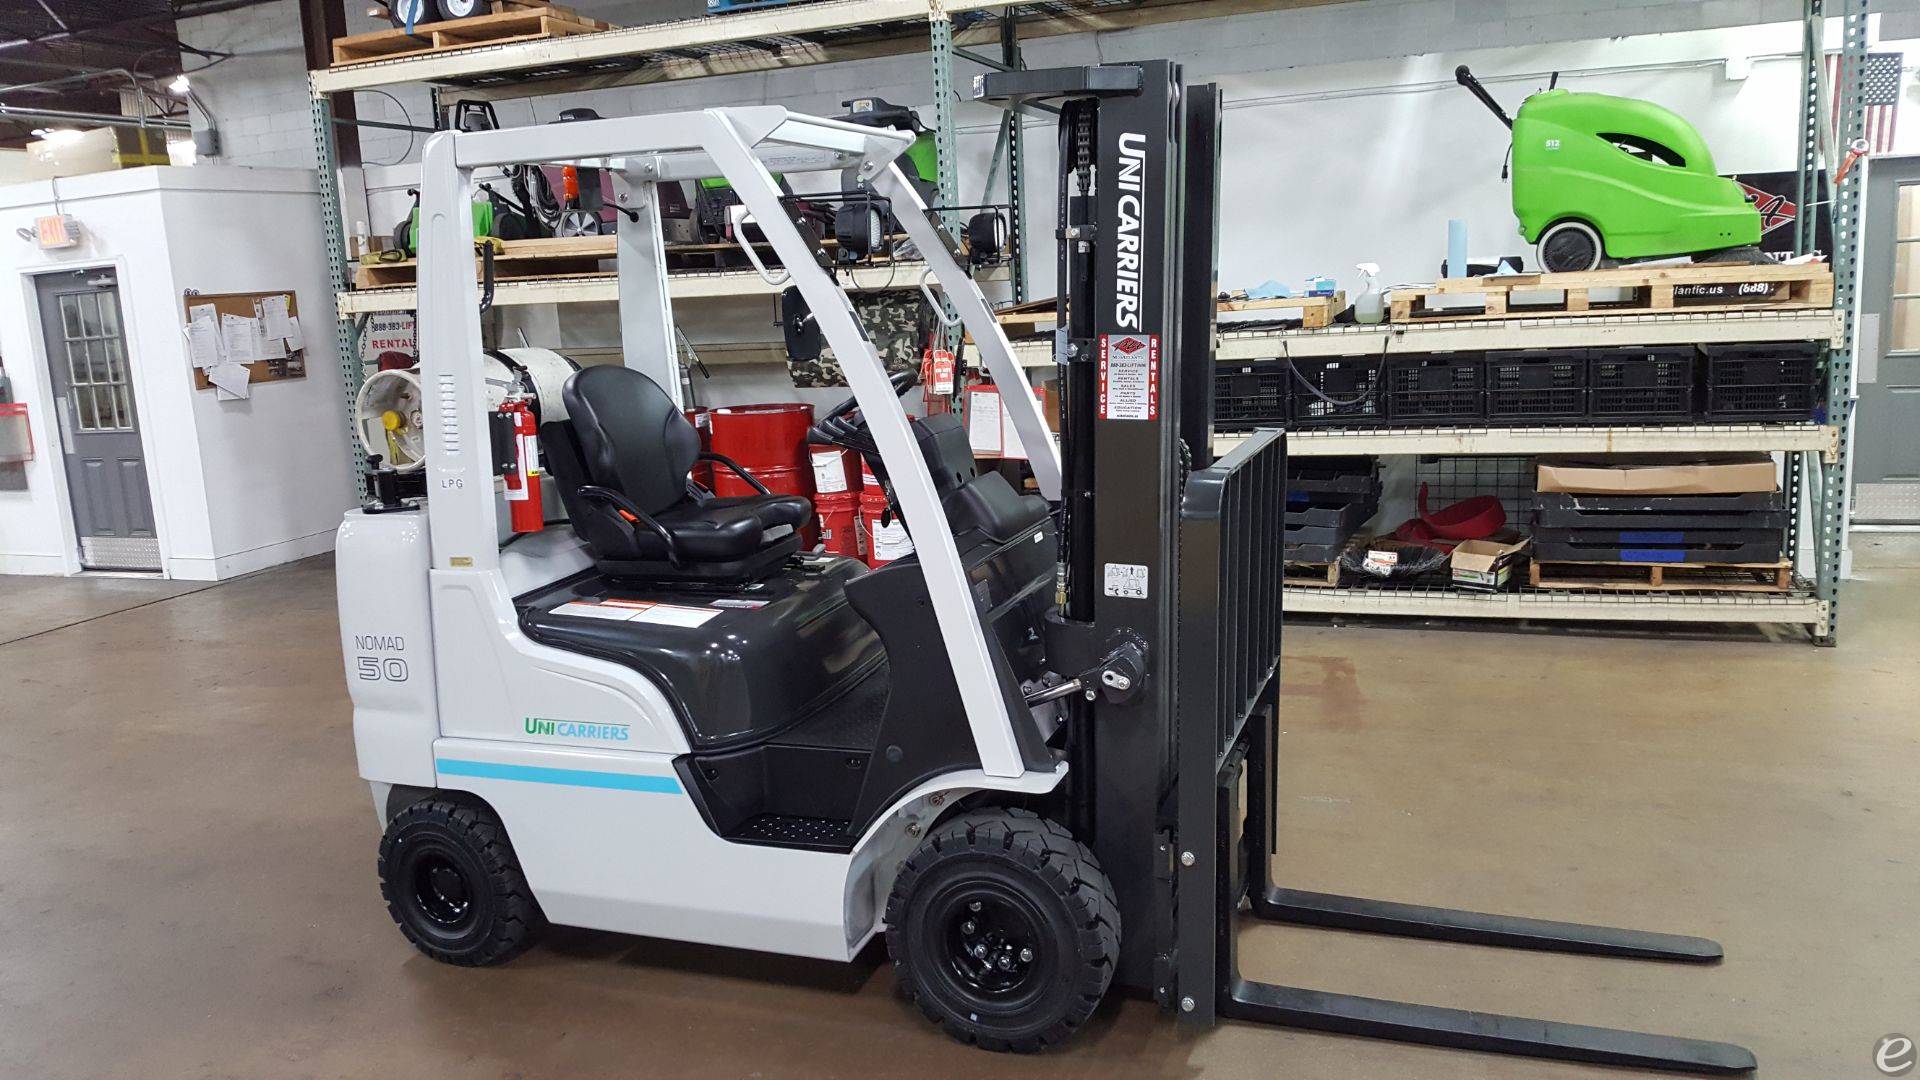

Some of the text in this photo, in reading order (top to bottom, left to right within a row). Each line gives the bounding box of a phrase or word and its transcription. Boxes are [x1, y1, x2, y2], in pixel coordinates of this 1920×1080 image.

[1149, 338, 1157, 415] RENTALS
[441, 478, 464, 489] LPG
[355, 634, 405, 651] NOMAD
[357, 656, 409, 682] 50
